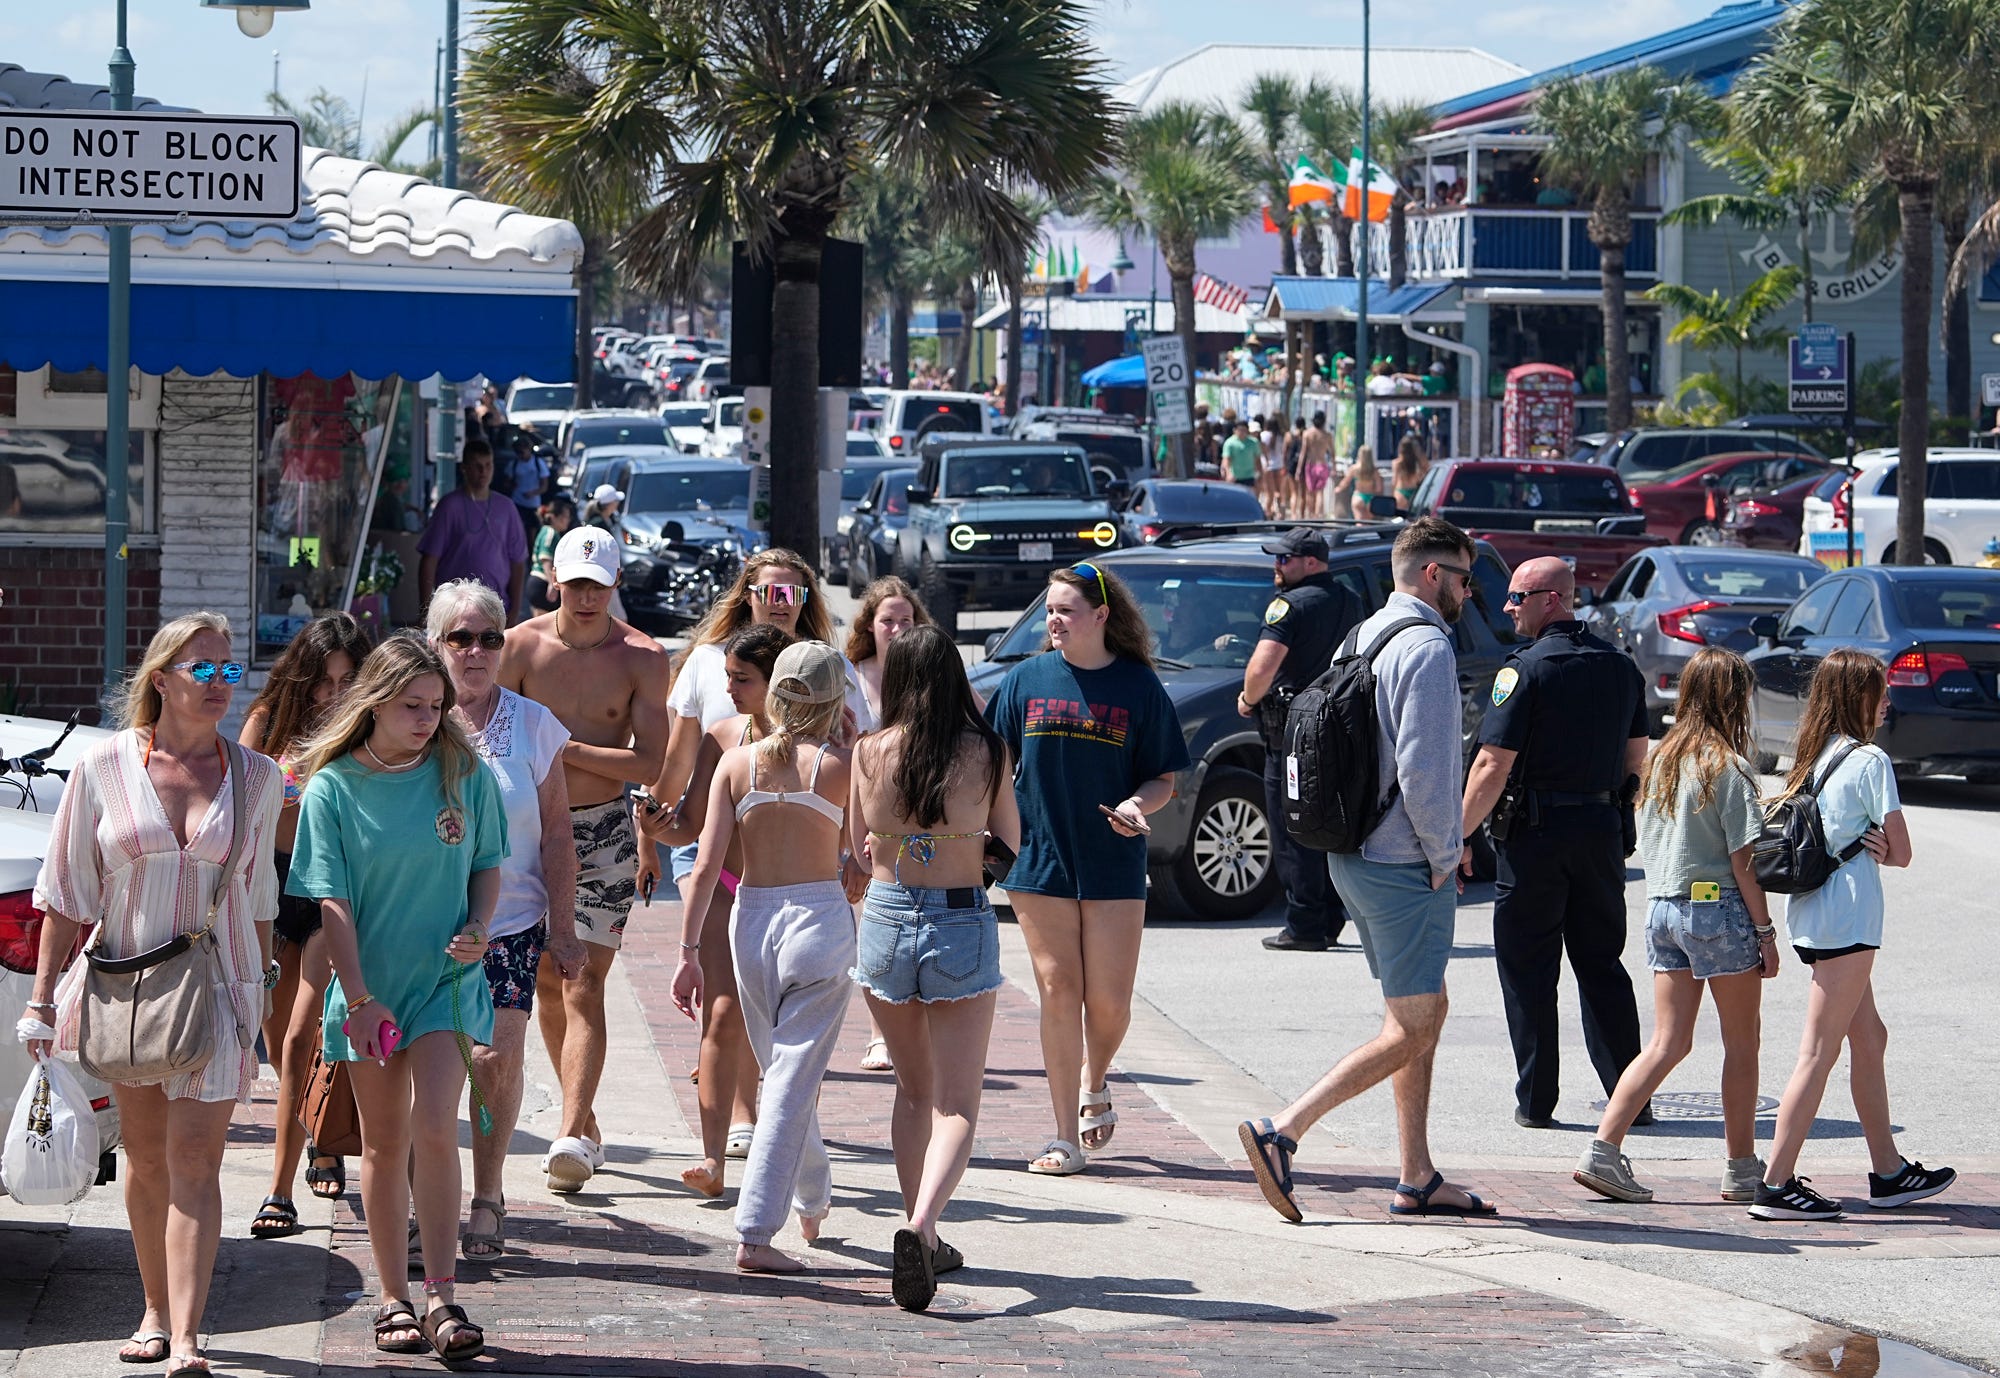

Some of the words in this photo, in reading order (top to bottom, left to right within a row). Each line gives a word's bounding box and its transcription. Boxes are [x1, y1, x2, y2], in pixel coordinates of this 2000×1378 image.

[5, 126, 49, 156] DO
[73, 128, 140, 158] NOT
[166, 131, 278, 163] BLOCK
[19, 166, 264, 202] INTERSECTION
[1826, 254, 1897, 299] GRILLE
[1145, 341, 1179, 352] SPEED
[1150, 352, 1176, 364] LIMIT
[1150, 363, 1183, 385] 20
[1792, 389, 1845, 403] PARKING
[993, 531, 1077, 541] BRONCO
[1026, 698, 1129, 727] SYLVA
[1050, 730, 1069, 738] NORTH
[1070, 732, 1096, 741] CAROLINA
